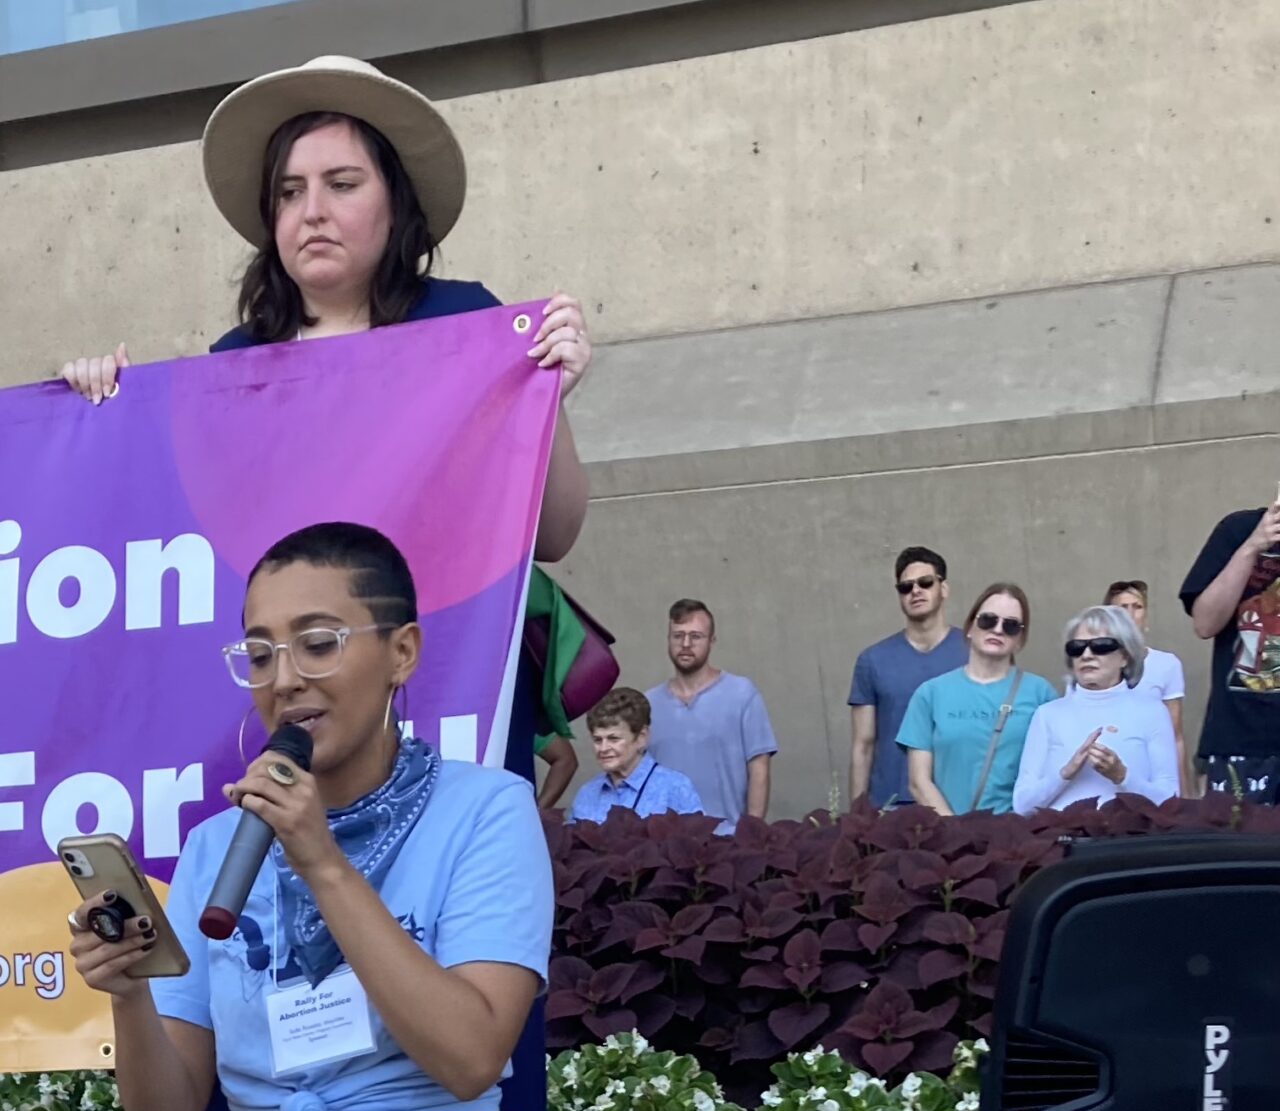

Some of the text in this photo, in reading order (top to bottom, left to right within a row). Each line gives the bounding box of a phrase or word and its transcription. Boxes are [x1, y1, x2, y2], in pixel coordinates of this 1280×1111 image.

[280, 997, 352, 1021] Abortion Justice
[294, 996, 317, 1007] Rally
